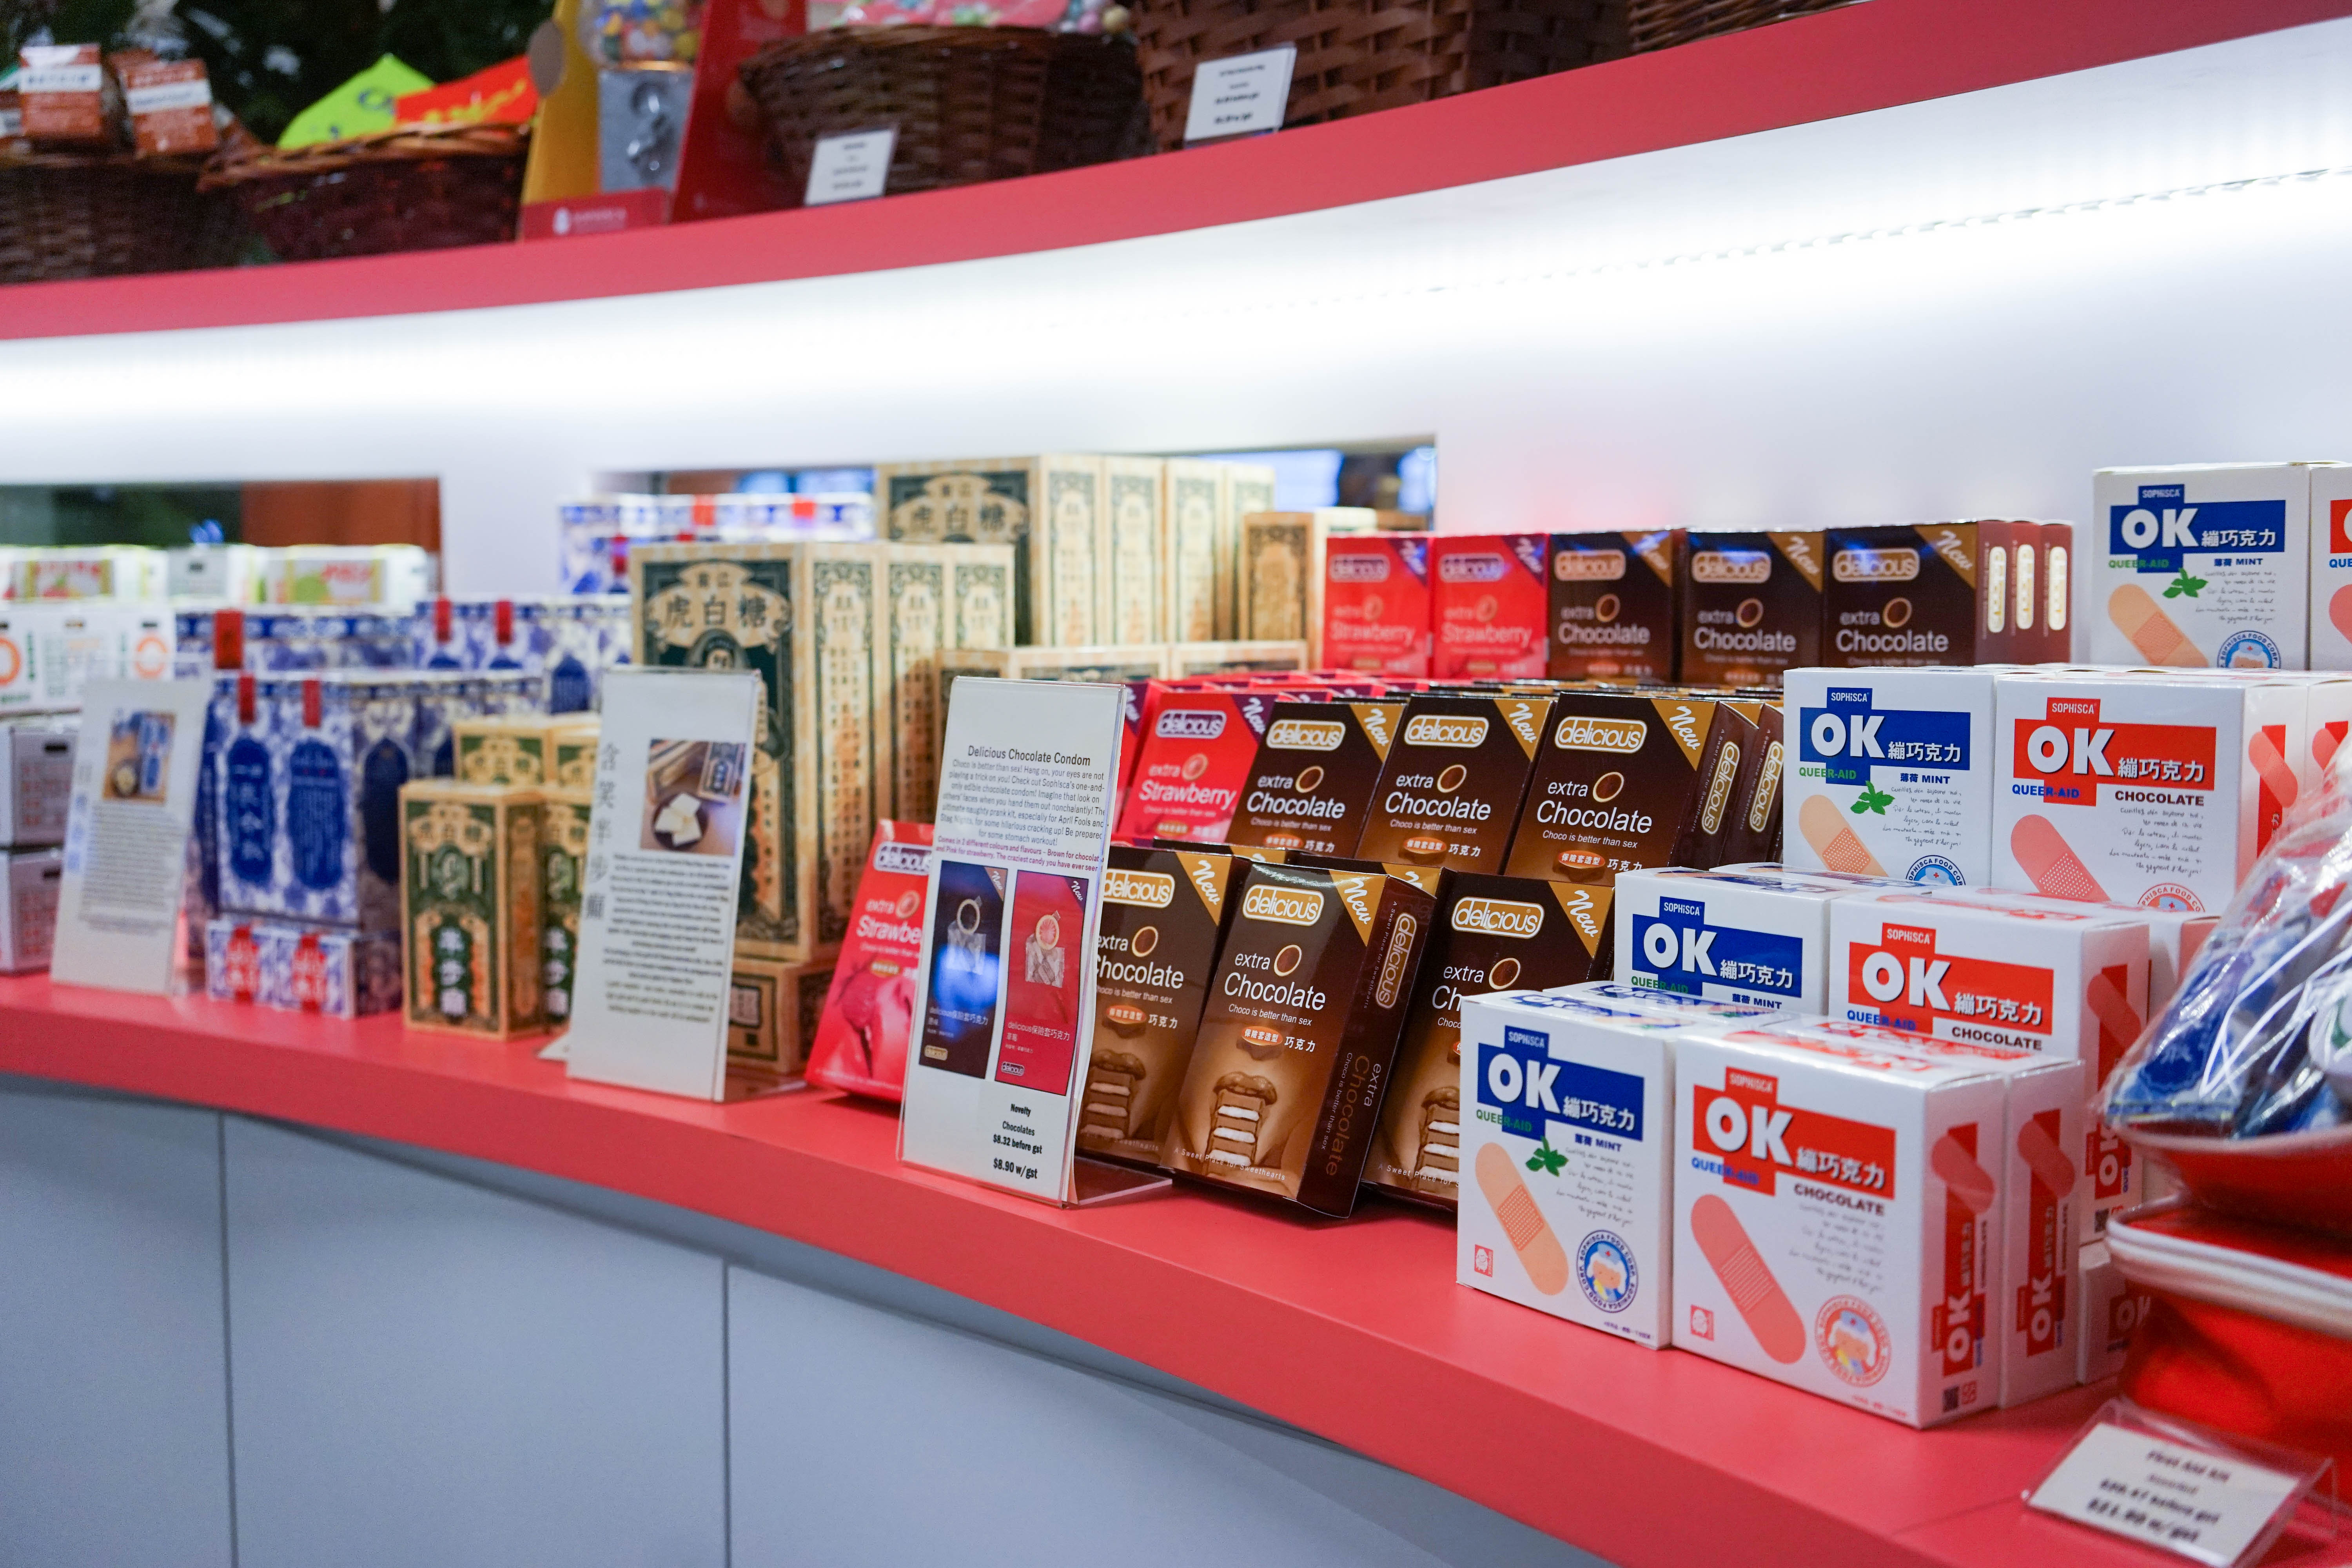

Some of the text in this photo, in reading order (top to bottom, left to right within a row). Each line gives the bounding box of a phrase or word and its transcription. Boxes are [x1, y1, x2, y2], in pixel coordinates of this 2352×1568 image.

[2122, 508, 2198, 548] OK
[1937, 530, 1973, 570] New
[2108, 559, 2169, 569] QUEER-AID
[1840, 610, 1880, 626] extra
[1558, 622, 1651, 644] Chocolate
[1693, 627, 1797, 653] Chocolate
[1836, 629, 1949, 653] Chocolate
[2248, 633, 2267, 643] FOOD
[1272, 722, 1341, 746] delicious
[1364, 708, 1390, 747] New
[1408, 717, 1483, 744] delicious
[1509, 702, 1537, 743] New
[1559, 718, 1641, 749] delicious
[1669, 706, 1701, 751] New
[1811, 713, 1961, 763] OK 繃巧克力
[968, 745, 1091, 766] Delicious Chocolate Condom
[2027, 725, 2205, 782] OK 繃巧克力
[1012, 775, 1029, 785] Check
[1042, 779, 1074, 789] Sophisca's
[1076, 783, 1105, 792] one-and-
[1024, 766, 1040, 776] Hang
[1067, 771, 1080, 779] eyes
[1094, 772, 1104, 780] not
[1258, 774, 1294, 789] extra
[1396, 774, 1434, 789] extra
[1799, 767, 1857, 779] QUEER-AID
[1900, 773, 1951, 784] 薄荷 MINT
[1011, 788, 1037, 797] condom!
[1038, 789, 1062, 800] Imagine
[1063, 793, 1076, 801] that
[1077, 793, 1090, 802] look
[1138, 779, 1238, 811] Strawberry
[1547, 781, 1588, 797] extra
[1704, 746, 1736, 829] delicious
[1751, 746, 1783, 827] delicious
[2012, 784, 2080, 799] QUEER-AID
[2115, 790, 2205, 806] CHOCOLATE
[1024, 800, 1039, 809] them
[1052, 804, 1093, 816] nonchalantly!
[1095, 807, 1105, 816] The
[1247, 790, 1346, 820] Chocolate
[1385, 791, 1491, 821] Chocolate
[1018, 812, 1091, 826] especially for April Fools
[1390, 818, 1413, 829] Choco
[1422, 821, 1444, 831] better
[1445, 824, 1461, 833] than
[1537, 800, 1652, 834] Chocolate
[1005, 833, 1058, 846] stomach workout!
[1027, 824, 1052, 835] cracking
[1065, 827, 1073, 836] Be
[1543, 829, 1638, 849] Choco is better than sex
[1020, 845, 1042, 855] flavours
[1047, 849, 1065, 858] Brown
[1448, 844, 1481, 857] 巧克力
[1058, 860, 1071, 868] have
[1561, 853, 1642, 872] 保險套造型 巧克力
[1909, 858, 1953, 881] OPHISCA FOOD
[1070, 880, 1084, 902] New
[1104, 873, 1170, 902] delicious
[1193, 860, 1221, 905] New
[2170, 886, 2192, 901] FOOD
[1247, 887, 1319, 920] delicious
[1344, 878, 1372, 924] New
[1388, 908, 1396, 931] Sweet
[1455, 902, 1538, 933] delicious
[1567, 890, 1599, 937] New
[1379, 932, 1390, 952] Place
[1235, 953, 1271, 970] extra
[1379, 916, 1414, 1004] delicious
[1644, 923, 1793, 989] OK 繃巧克力
[1443, 966, 1485, 984] extra
[1632, 976, 1688, 995] QUEER-AID
[1224, 972, 1326, 1011] Chocolate
[1363, 965, 1379, 1009] Sweethearts
[1862, 951, 2043, 1026] OK 繃巧克力
[1229, 1004, 1312, 1026] Choco is better than sex
[1754, 998, 1782, 1009] MINT
[1147, 1014, 1178, 1029] 巧克力
[1437, 1017, 1461, 1029] Choco
[1847, 1009, 1916, 1031] QUEER-AID
[1244, 1028, 1316, 1053] 保險套造型 巧克力
[1952, 1026, 2042, 1052] CHOCOLATE
[1341, 1052, 1353, 1079] Choco
[1364, 1063, 1382, 1107] extra
[1488, 1053, 1562, 1114] OK
[1010, 1103, 1032, 1118] Novelty
[1332, 1089, 1343, 1113] better
[1326, 1055, 1370, 1176] Chocolate
[1327, 1114, 1336, 1133] than
[1476, 1109, 1532, 1133] QUEER-AID
[1002, 1120, 1036, 1136] Chocolates
[1706, 1096, 1794, 1167] OK
[993, 1134, 1042, 1154] $8.32 before gst
[1321, 1135, 1330, 1151] sex
[1596, 1139, 1622, 1152] MINT
[993, 1157, 1038, 1180] $8.90 w/gst
[1181, 1149, 1285, 1180] Sweet Place Sweethearts
[1387, 1165, 1436, 1182] Sweet Place
[1794, 1183, 1886, 1216] CHOCOLATE
[1948, 1288, 1971, 1363] OK
